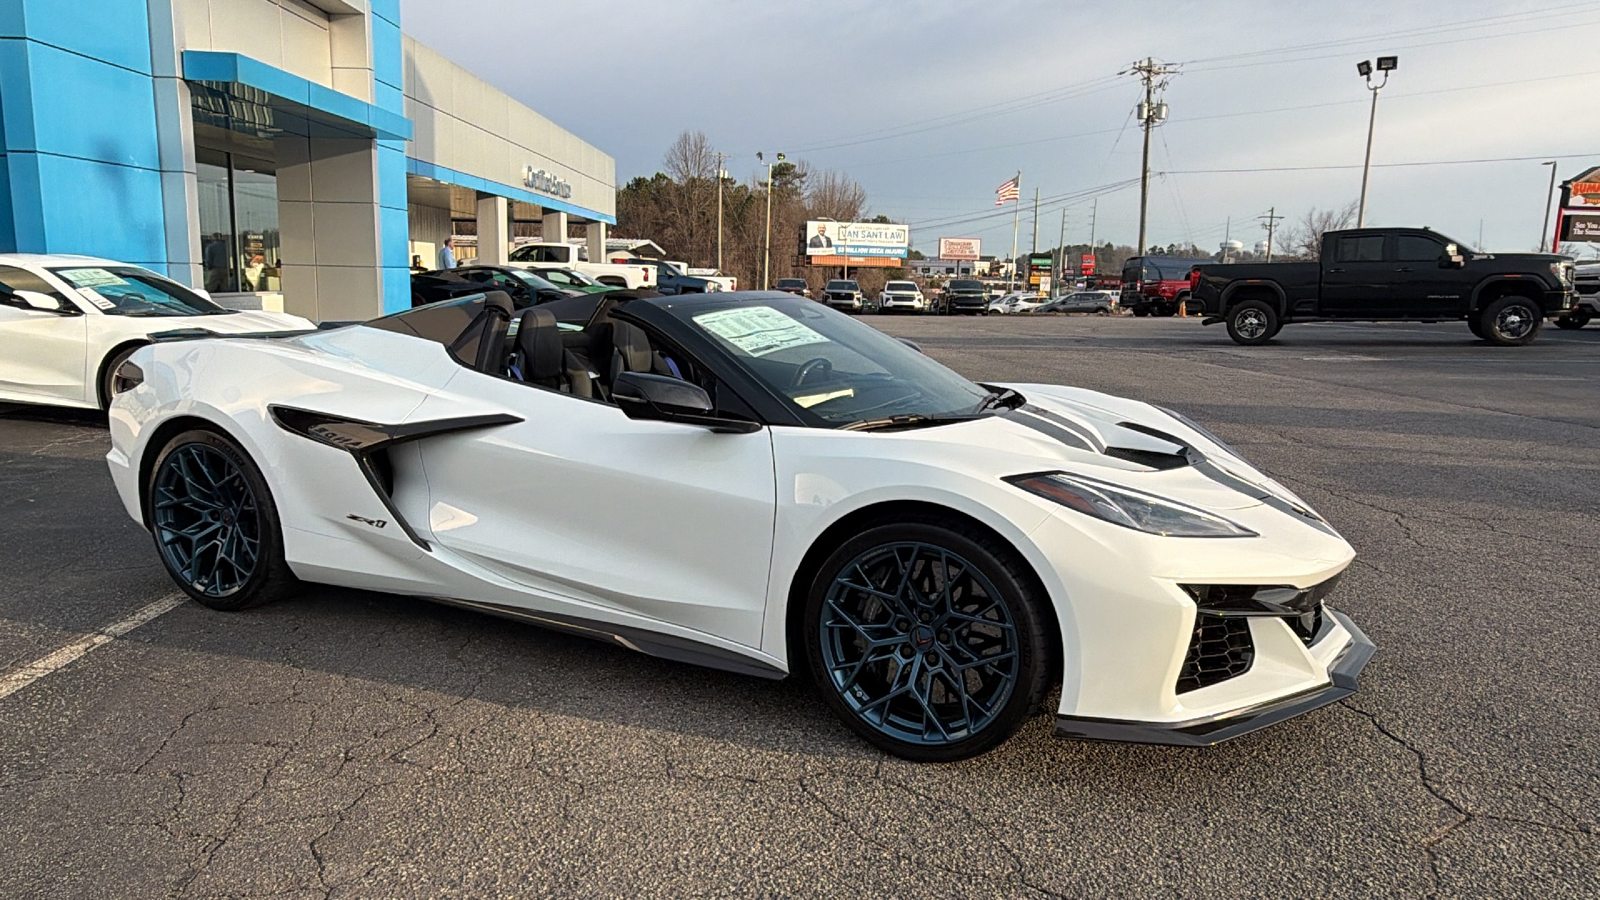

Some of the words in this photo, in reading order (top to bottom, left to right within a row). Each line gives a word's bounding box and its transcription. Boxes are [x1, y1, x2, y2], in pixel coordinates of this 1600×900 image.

[841, 230, 859, 239] VAN
[861, 230, 883, 239] SANT
[884, 231, 903, 240] LAW
[846, 246, 868, 254] MILLION
[868, 247, 884, 255] NECK
[884, 248, 906, 256] INJURY
